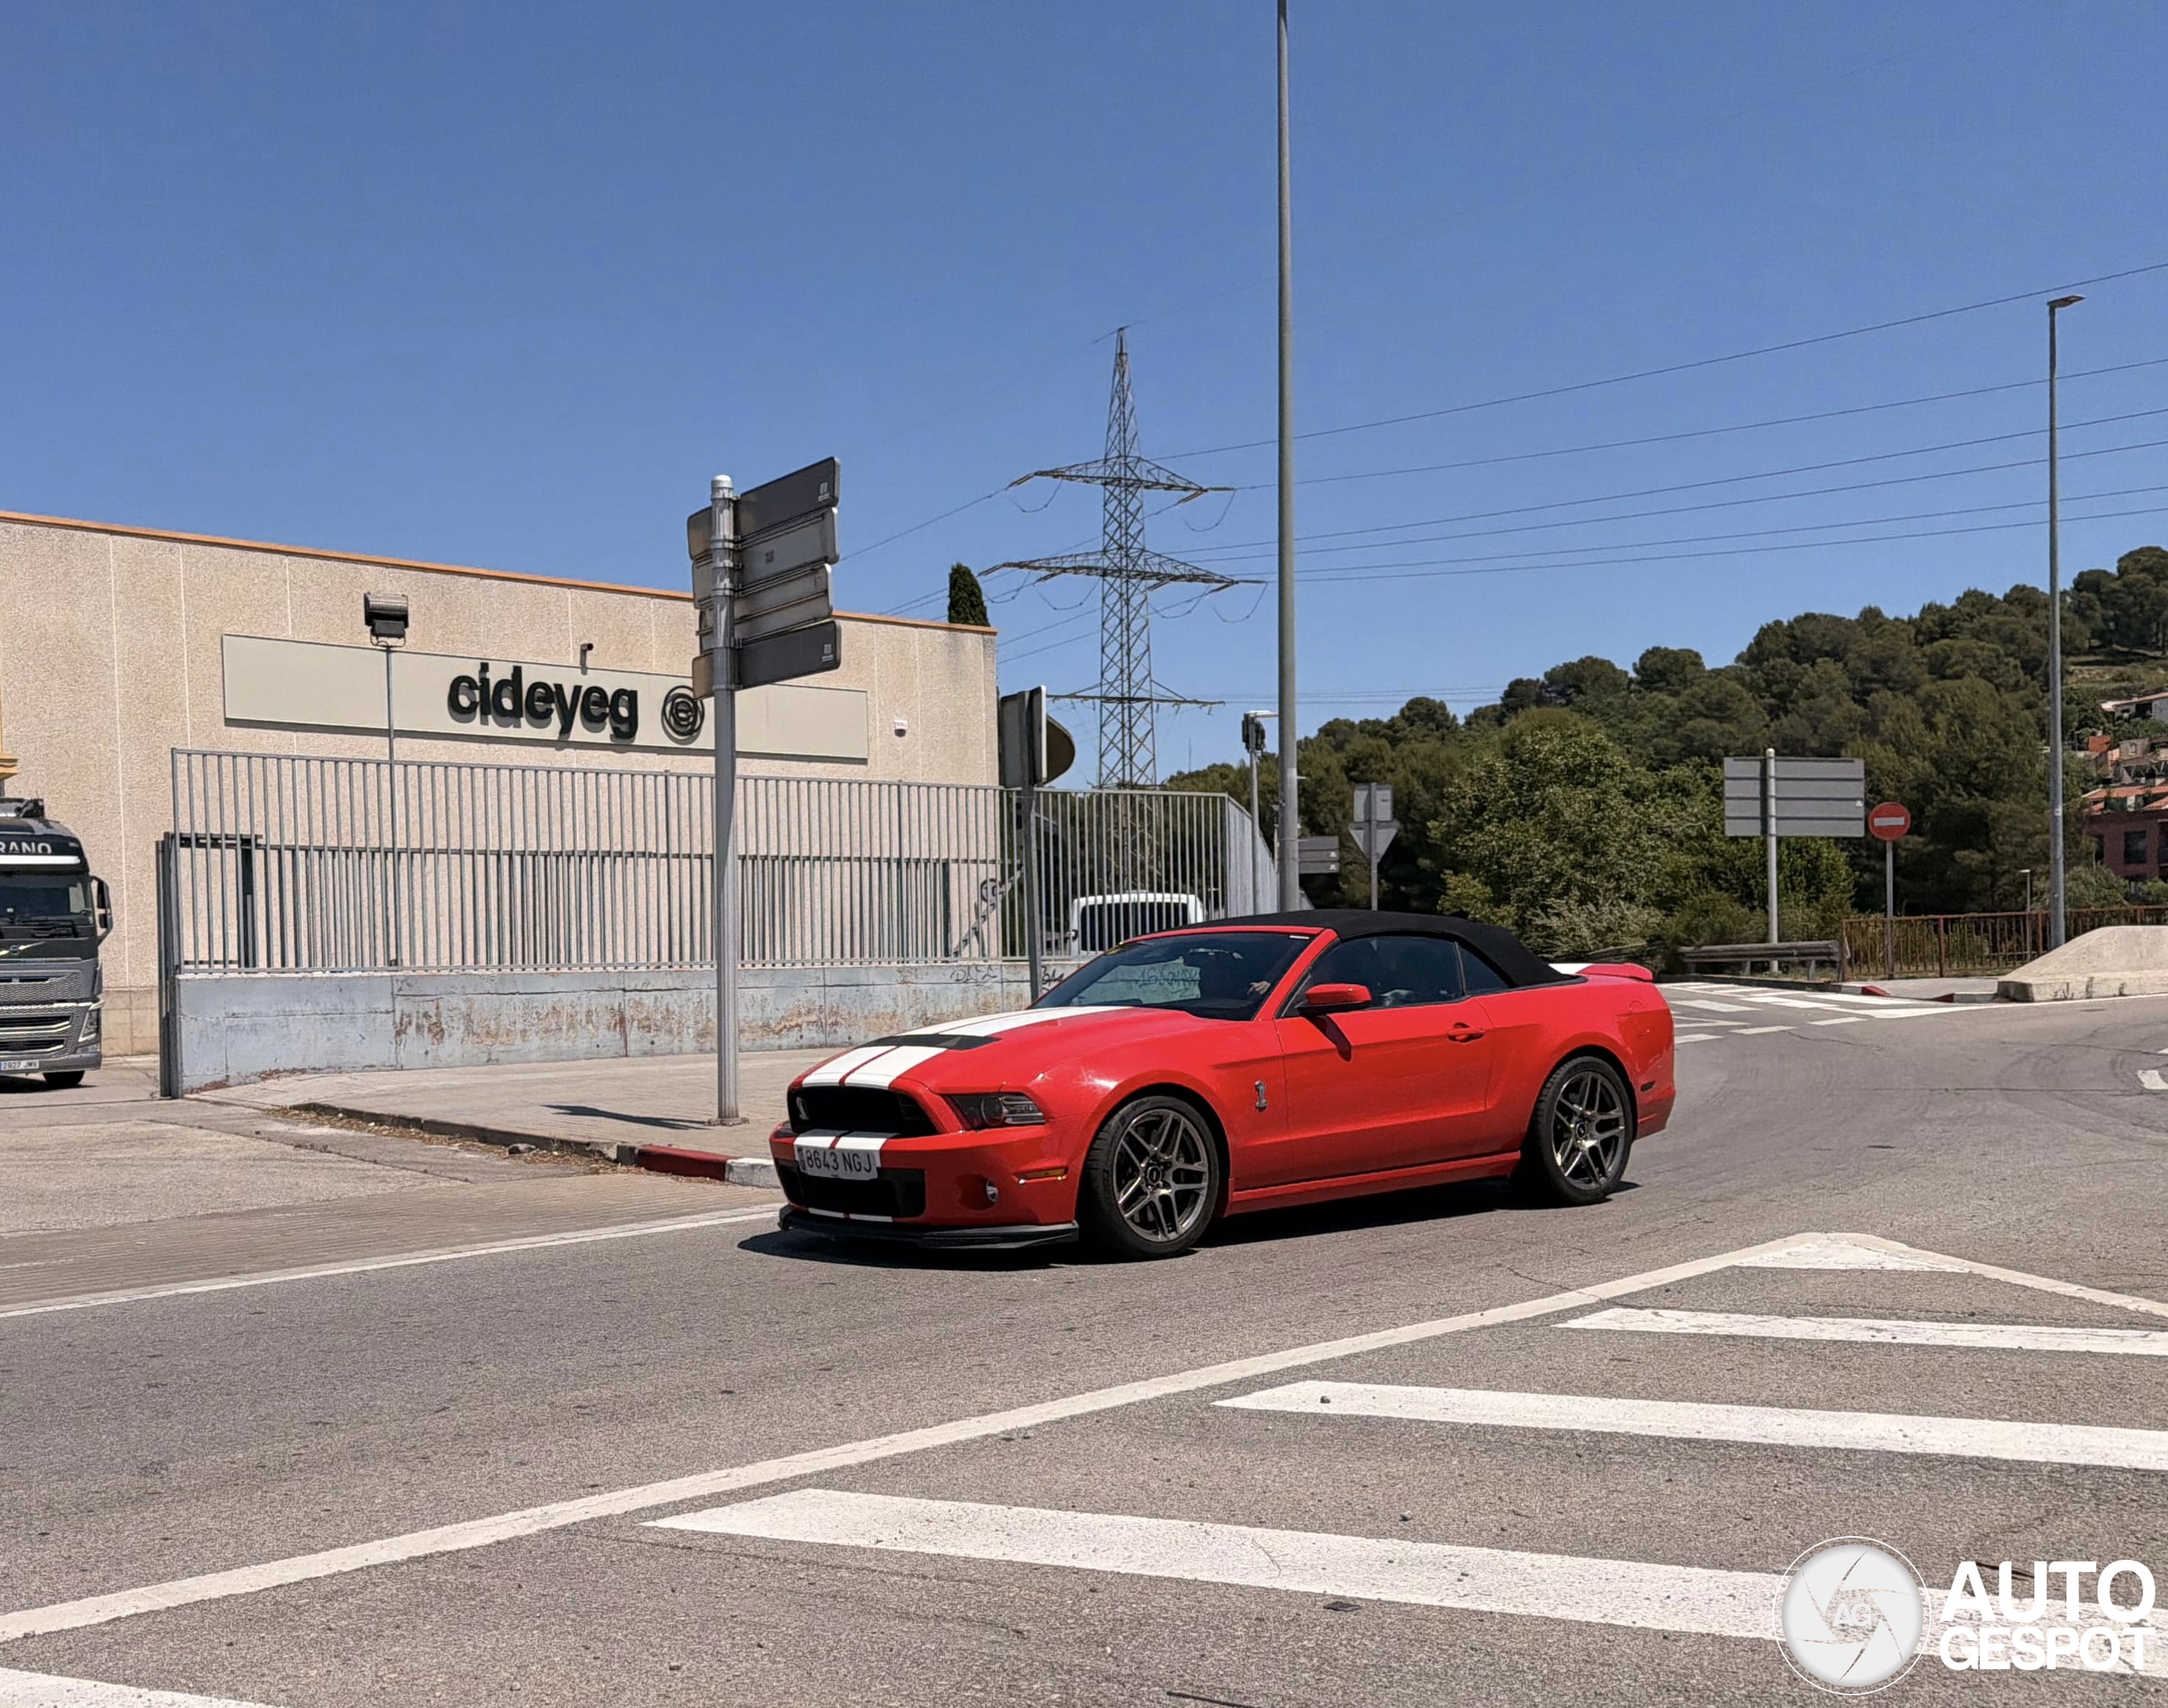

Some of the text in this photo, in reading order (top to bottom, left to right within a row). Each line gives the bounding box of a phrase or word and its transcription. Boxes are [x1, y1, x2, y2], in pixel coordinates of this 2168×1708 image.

[448, 662, 639, 738] cideyeg
[3, 1061, 22, 1070] 2927
[805, 1149, 839, 1170] 8643
[842, 1152, 871, 1173] NGJ
